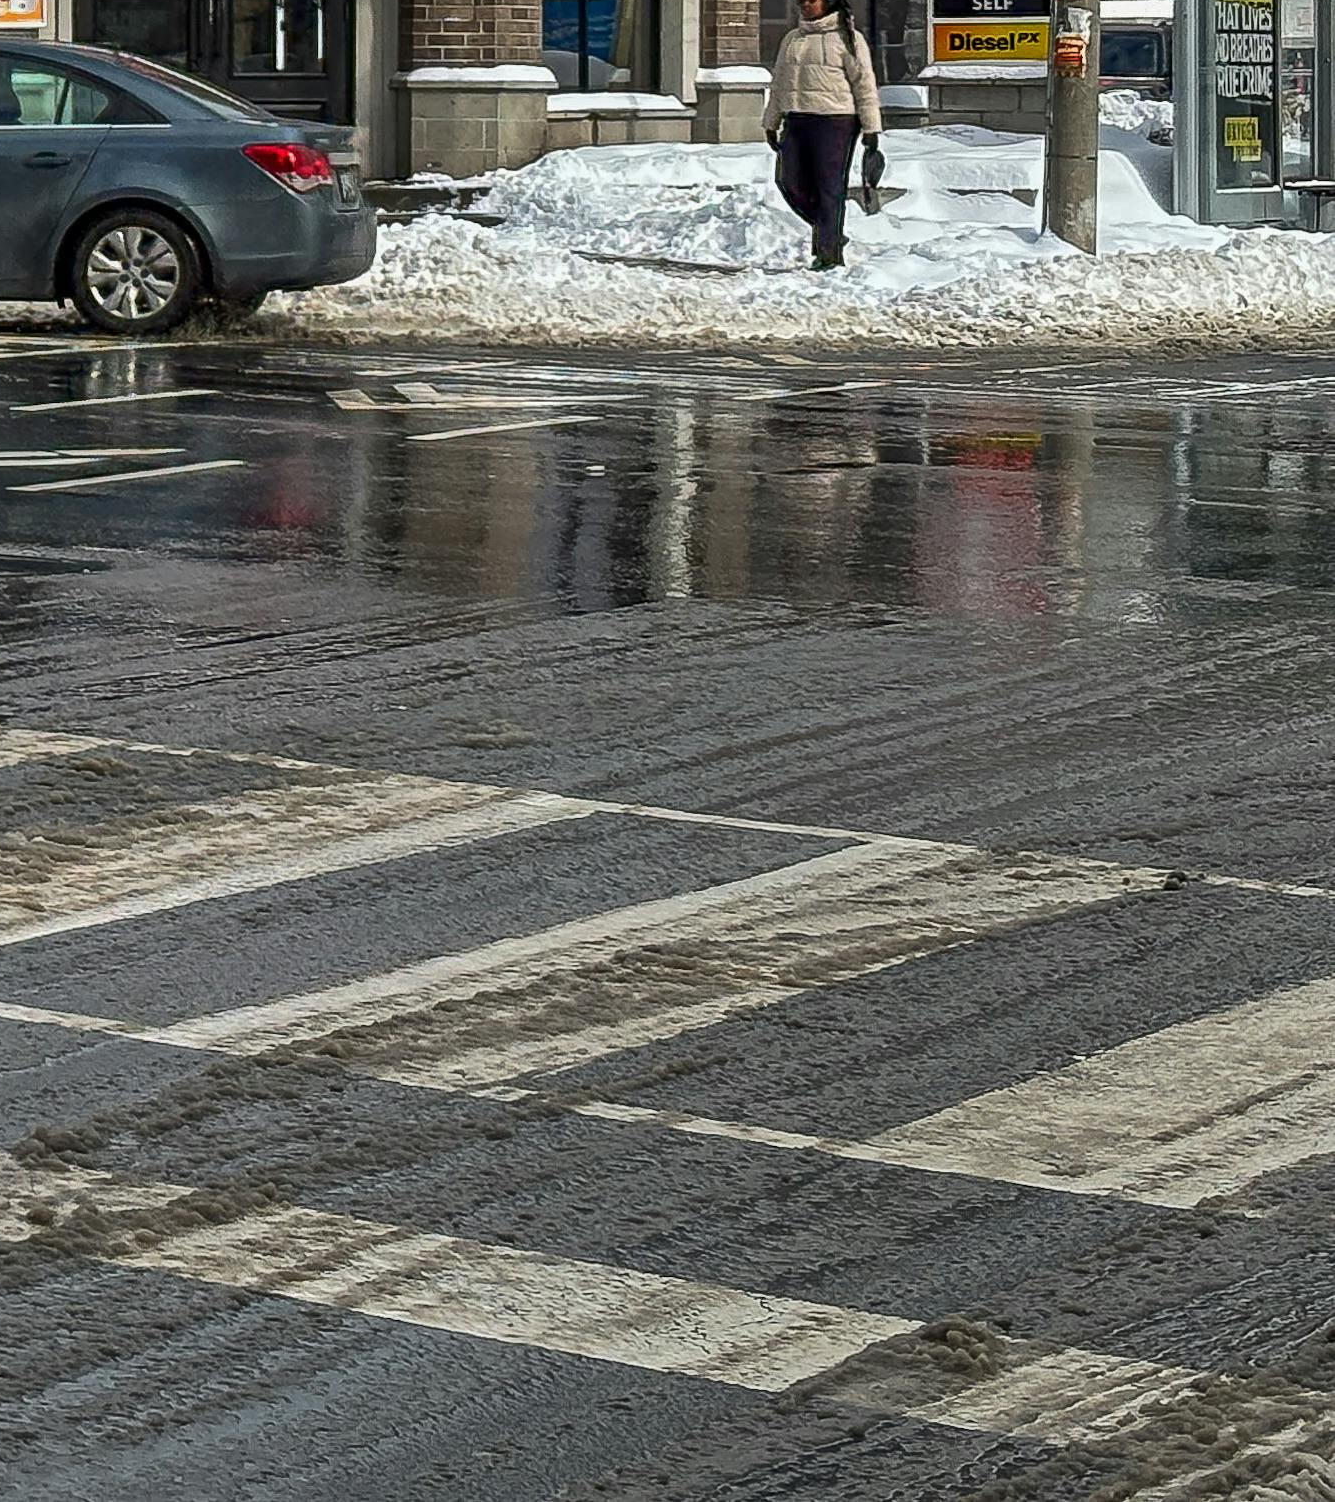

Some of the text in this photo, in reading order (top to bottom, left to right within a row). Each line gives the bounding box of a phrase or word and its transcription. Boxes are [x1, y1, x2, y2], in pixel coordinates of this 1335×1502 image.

[1241, 4, 1273, 30] LIVES
[949, 33, 1016, 51] Diesel
[1230, 33, 1273, 63] BREATHES
